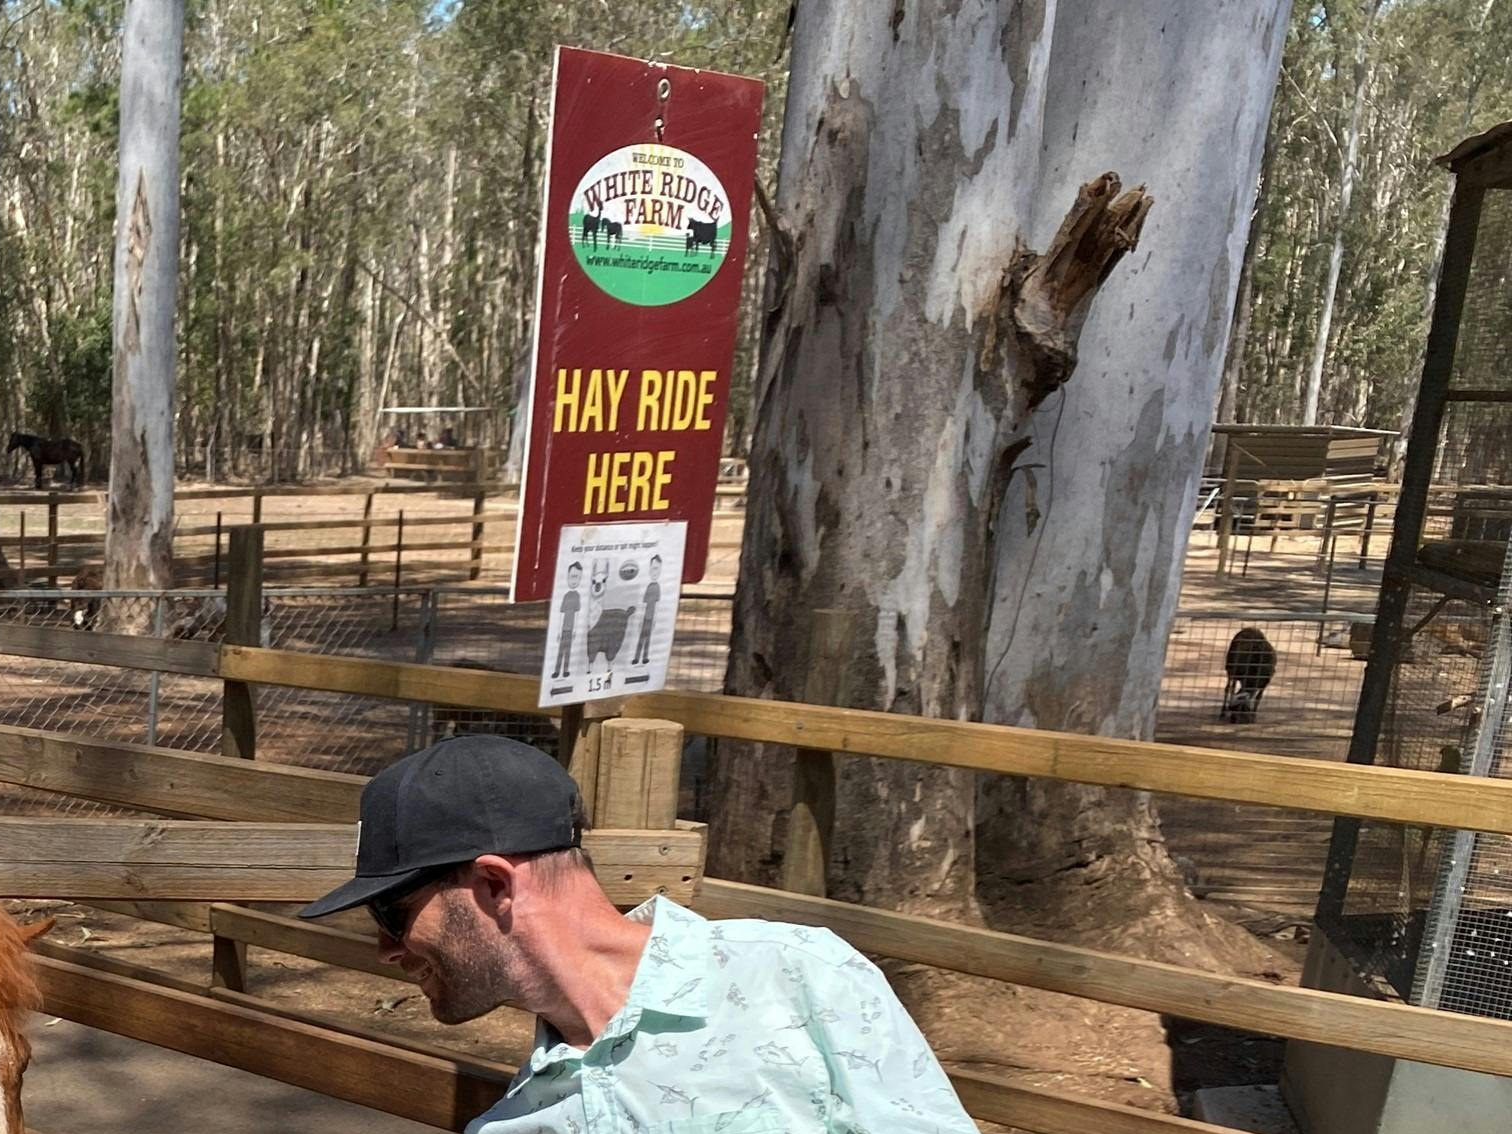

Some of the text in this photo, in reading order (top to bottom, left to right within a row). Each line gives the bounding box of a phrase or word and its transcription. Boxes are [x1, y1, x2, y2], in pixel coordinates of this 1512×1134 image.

[632, 152, 685, 169] WELCOME TO
[584, 170, 724, 221] WHITE RIDGE
[623, 198, 685, 230] FARM
[586, 254, 712, 274] www.whiteridgefarm.com.au
[553, 369, 717, 433] HAY RIDE
[583, 450, 676, 515] HERE
